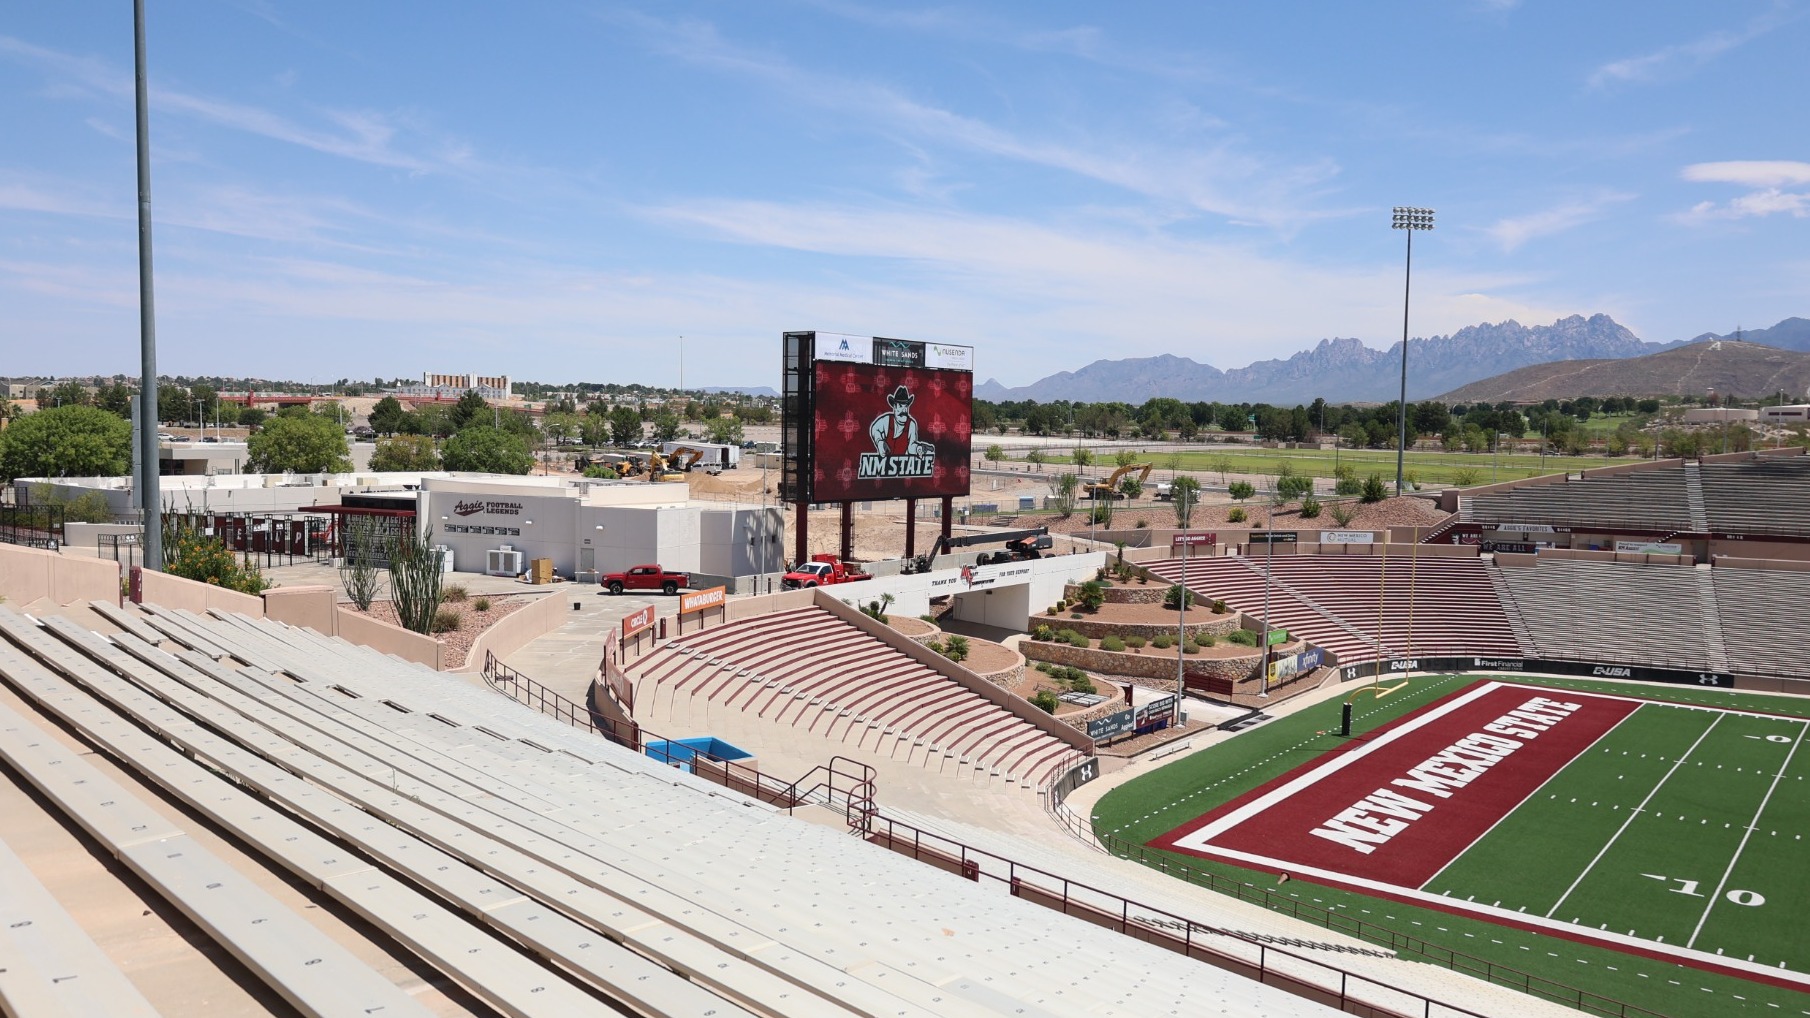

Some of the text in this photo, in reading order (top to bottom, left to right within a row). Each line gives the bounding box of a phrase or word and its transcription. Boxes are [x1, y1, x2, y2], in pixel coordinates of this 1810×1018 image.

[881, 349, 918, 359] WHITE SANDS
[860, 454, 933, 476] NM STATE
[454, 500, 523, 515] Aggie FOOTBALL
[684, 590, 723, 610] WHATABURGER
[1302, 651, 1319, 668] xfinity
[1090, 727, 1104, 736] WHITE
[1105, 722, 1118, 731] SANDS
[1309, 697, 1582, 854] NEW MEXICO STATE
